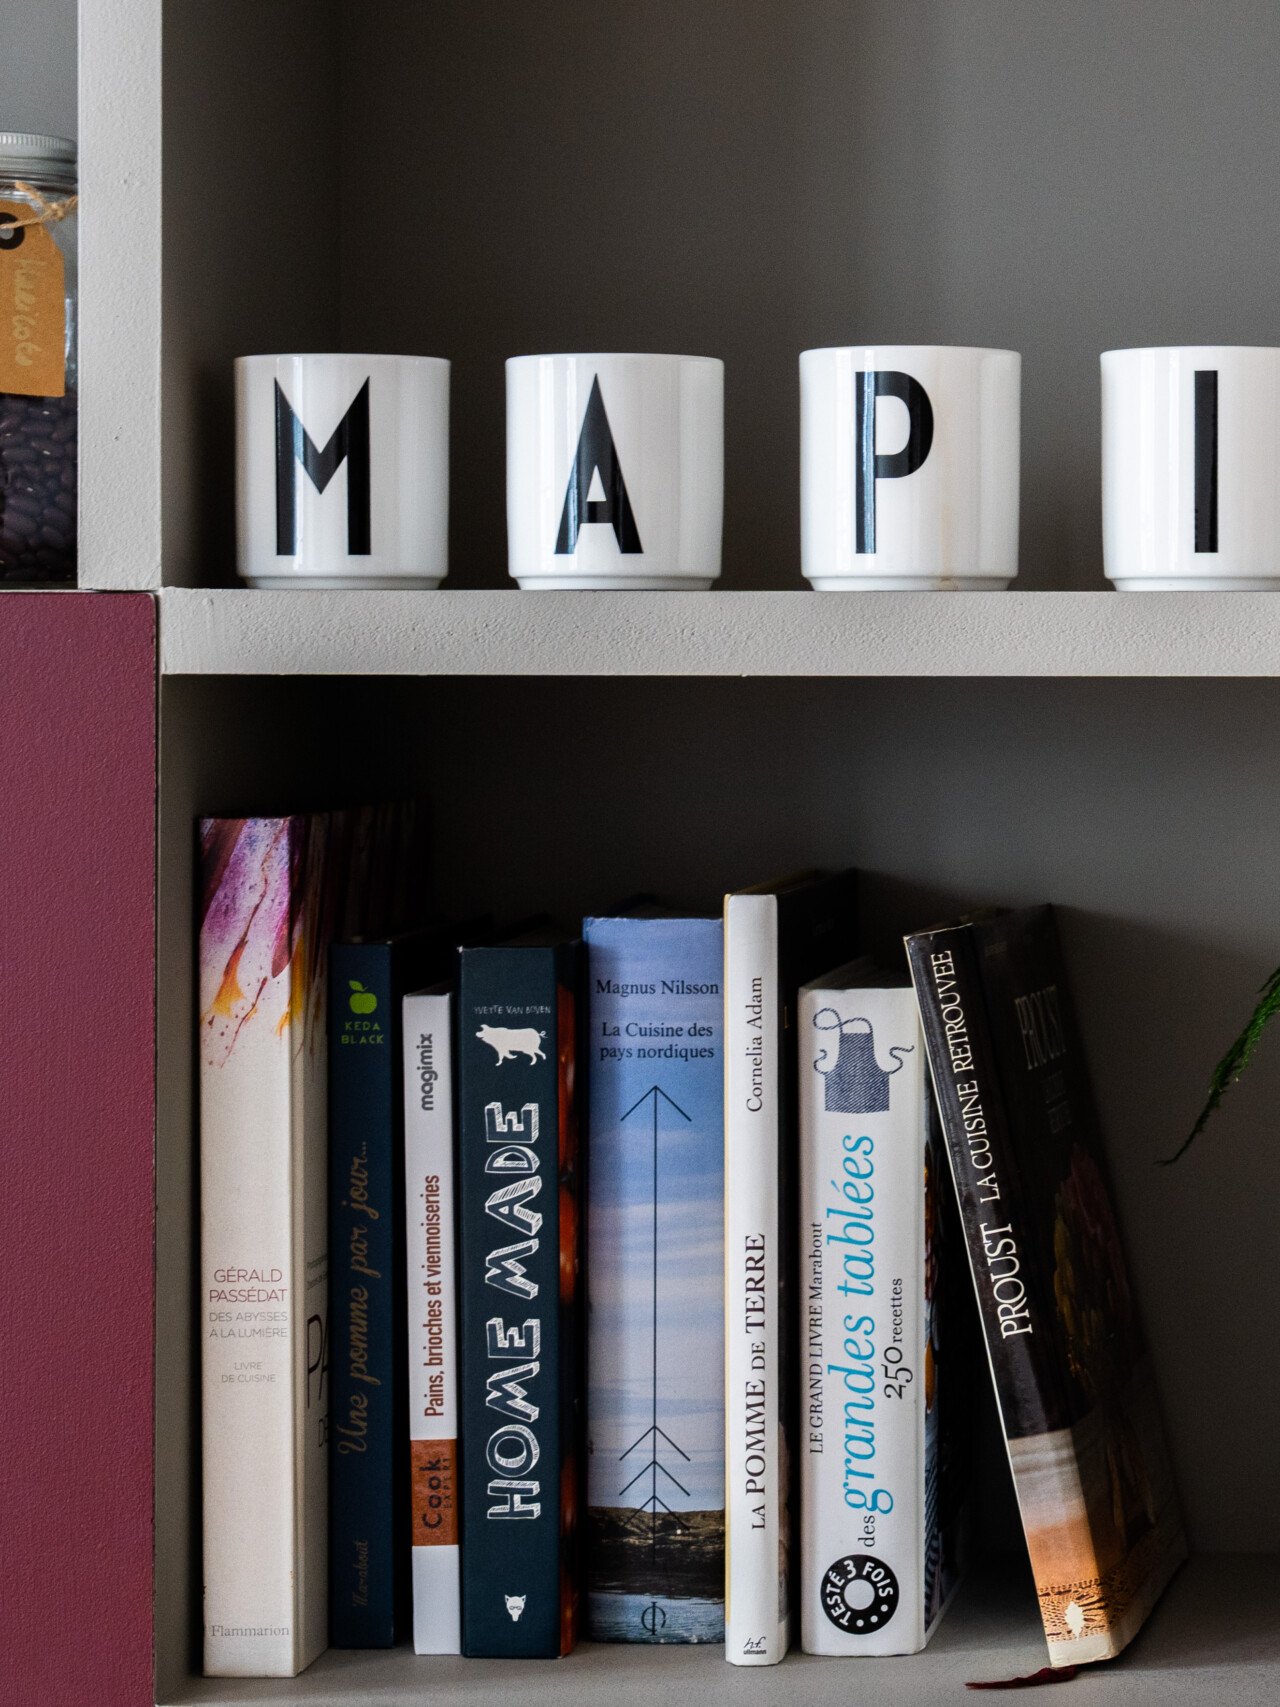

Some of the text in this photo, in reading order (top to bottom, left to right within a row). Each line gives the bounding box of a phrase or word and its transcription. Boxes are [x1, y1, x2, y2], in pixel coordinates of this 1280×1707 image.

[274, 375, 371, 556] M
[553, 372, 644, 554] A
[855, 370, 934, 554] P
[1194, 369, 1218, 553] I
[473, 1004, 552, 1015] YVETTE VAN BOVEN
[596, 979, 719, 998] Magnus Nilsson
[341, 1034, 384, 1045] BLACK
[345, 1022, 381, 1031] KEDA
[600, 1042, 715, 1063] pays nordiques
[602, 1022, 714, 1038] La Cuisine des
[745, 976, 763, 1112] Cornelia Adam
[416, 1033, 438, 1111] magimix
[930, 950, 1034, 1340] PROUST LA CUISINE RETROUVEE
[213, 1266, 283, 1283] GÉRALD
[350, 1225, 381, 1278] par
[209, 1286, 288, 1302] PASSÉDAT
[209, 1311, 288, 1323] DES ABYSSES
[420, 1174, 444, 1417] Pains, brioches et viennoiseries
[485, 1102, 543, 1520] HOME MADE
[220, 1327, 236, 1338] LA
[238, 1325, 288, 1338] LUMIÈRE
[350, 1285, 381, 1386] pomme
[808, 1222, 823, 1454] LE GRAND LIVRE Marabout
[827, 1135, 894, 1547] des grandes tablées
[884, 1278, 913, 1400] 250 recettes
[221, 1373, 276, 1383] DE CUISINE
[235, 1361, 263, 1371] LIVRE
[745, 1233, 766, 1530] LA POMME DE TERRE
[337, 1392, 369, 1454] Une
[419, 1458, 442, 1529] Cook
[443, 1458, 452, 1509] EXPERT
[826, 1559, 894, 1626] TESTÉ 3 FOIS
[211, 1625, 291, 1637] Flammarion
